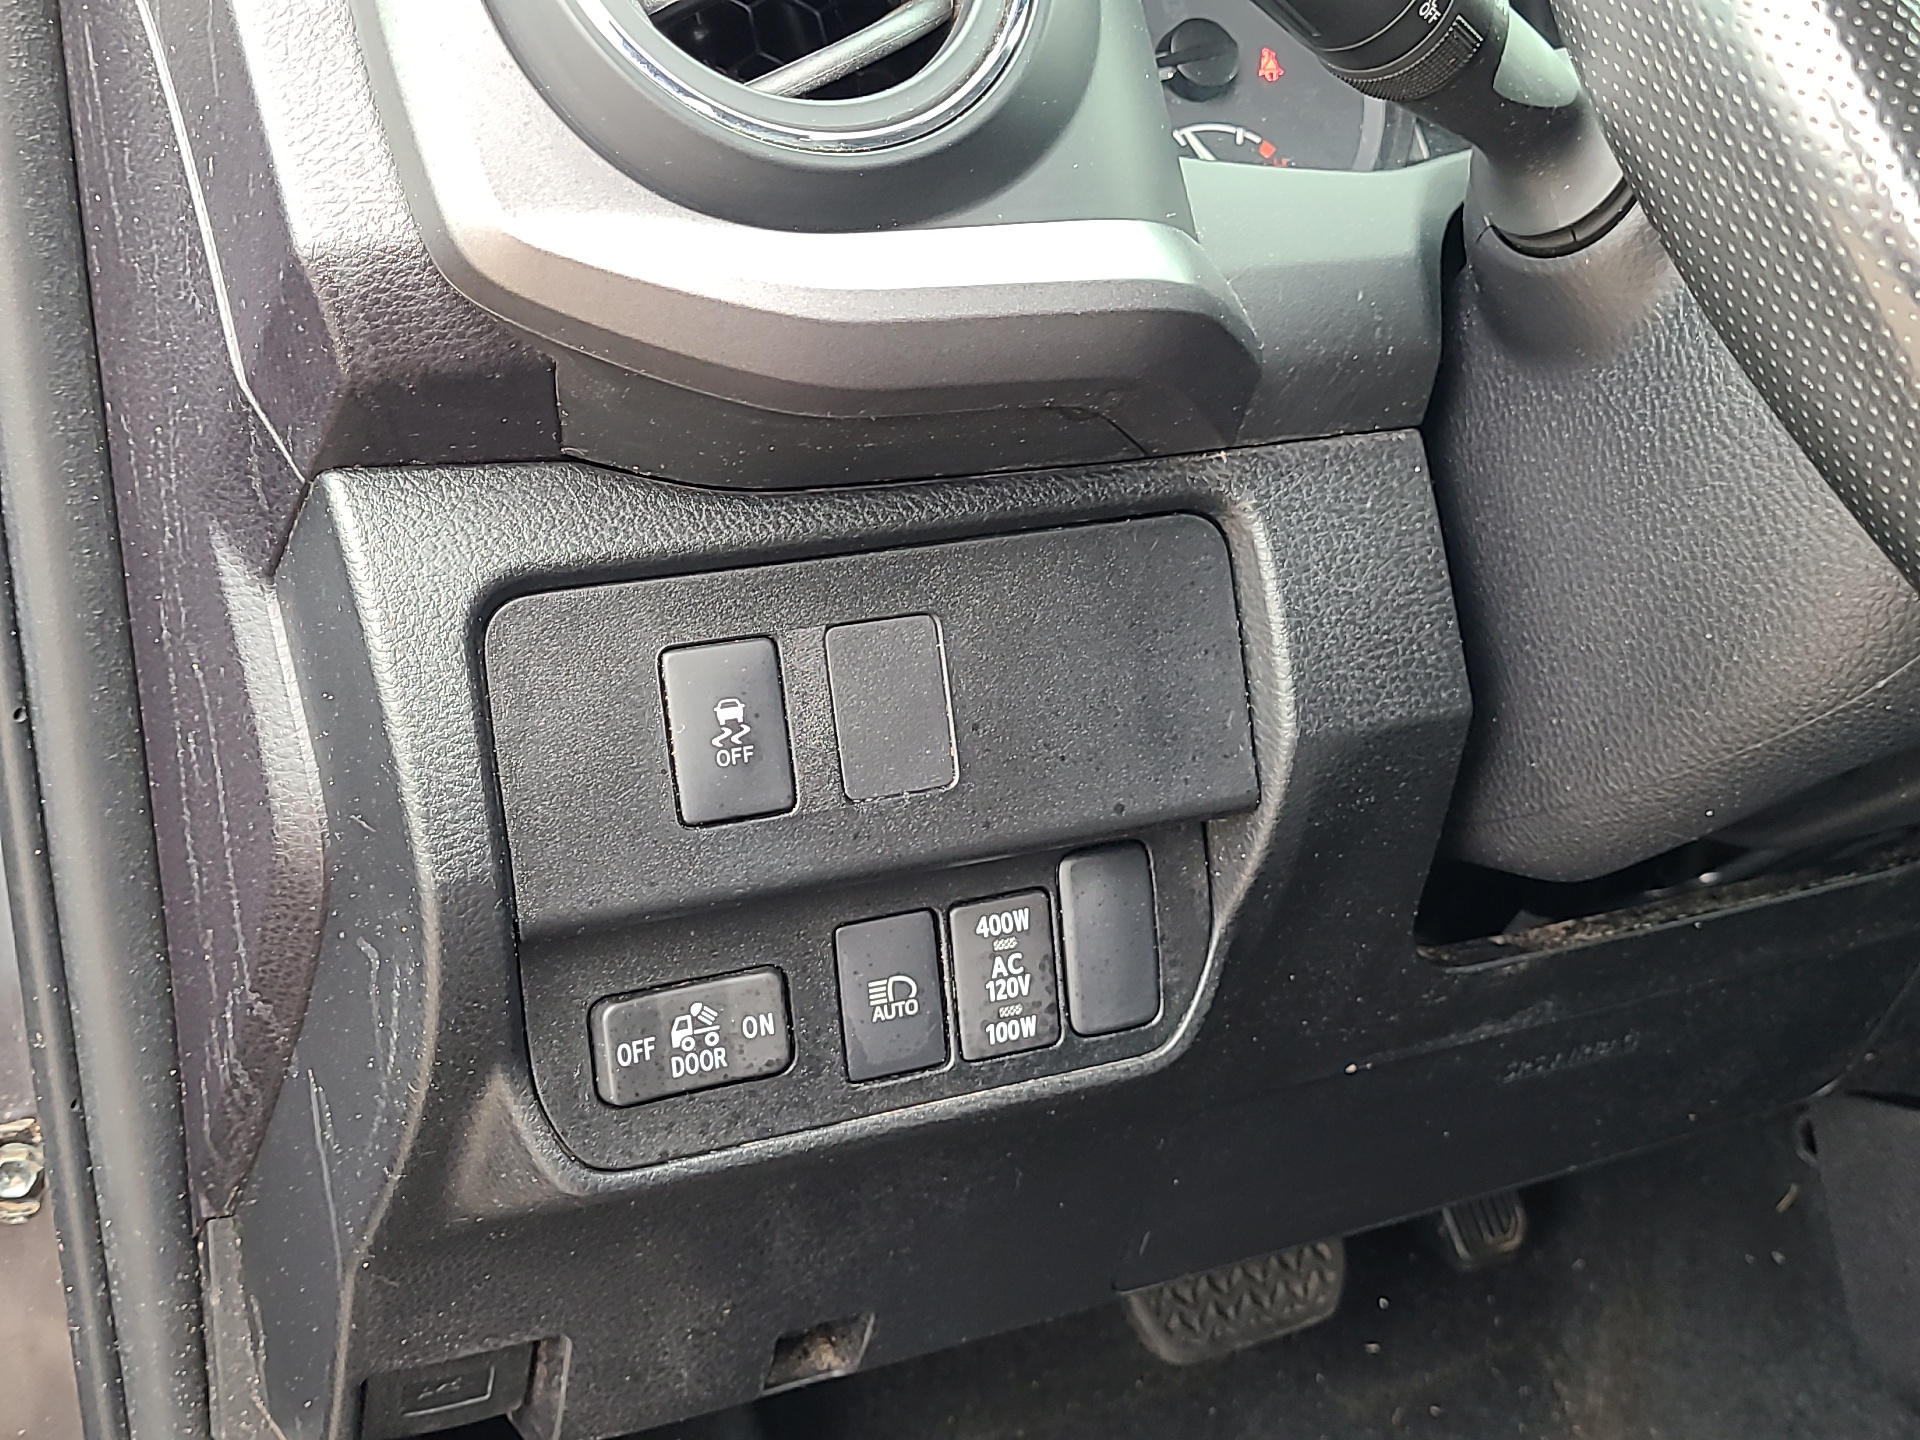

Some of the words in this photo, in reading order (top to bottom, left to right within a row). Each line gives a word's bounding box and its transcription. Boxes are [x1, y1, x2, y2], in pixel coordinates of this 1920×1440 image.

[1419, 1, 1442, 24] OFF
[716, 744, 754, 767] OFF
[975, 907, 1030, 938] 400W
[991, 952, 1024, 979] AC
[985, 973, 1031, 1003] 120V
[872, 998, 919, 1023] AUTO
[742, 1012, 775, 1039] ON
[985, 1014, 1037, 1046] 100W
[617, 1036, 656, 1067] OFF
[670, 1047, 728, 1079] DOOR
